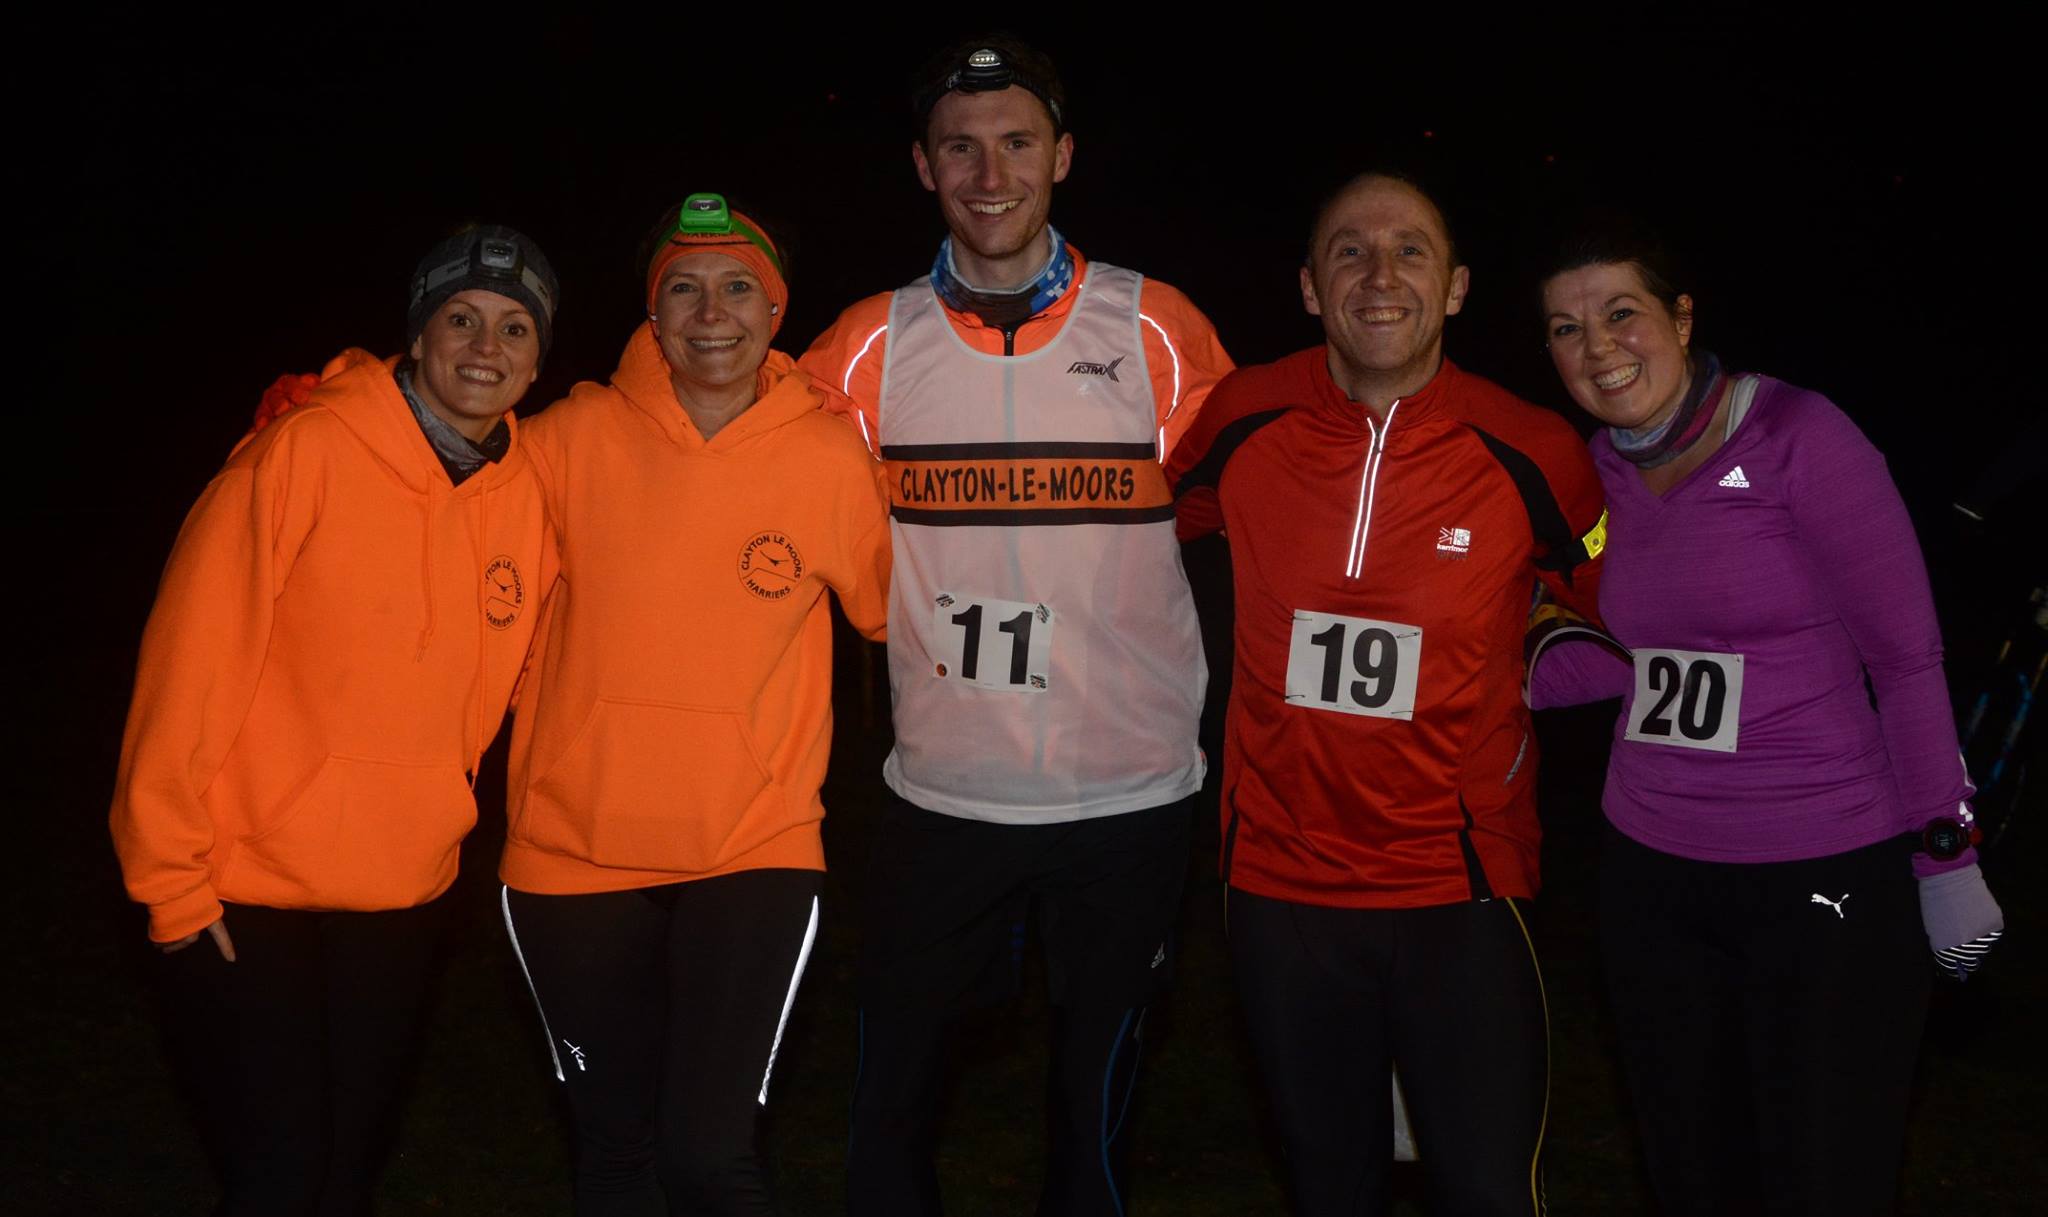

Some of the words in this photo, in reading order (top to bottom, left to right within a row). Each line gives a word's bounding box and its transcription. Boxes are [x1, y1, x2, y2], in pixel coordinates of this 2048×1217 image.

[901, 466, 1135, 503] CLAYTON-LE-MOORS
[1718, 479, 1750, 488] adidas
[502, 560, 511, 570] LE
[741, 534, 771, 571] CLAYTON
[773, 534, 785, 546] LE
[784, 543, 802, 578] MOORS
[746, 579, 792, 599] HARRIERS
[951, 603, 1033, 685] 11
[1310, 622, 1399, 709] 19
[1638, 656, 1727, 741] 20
